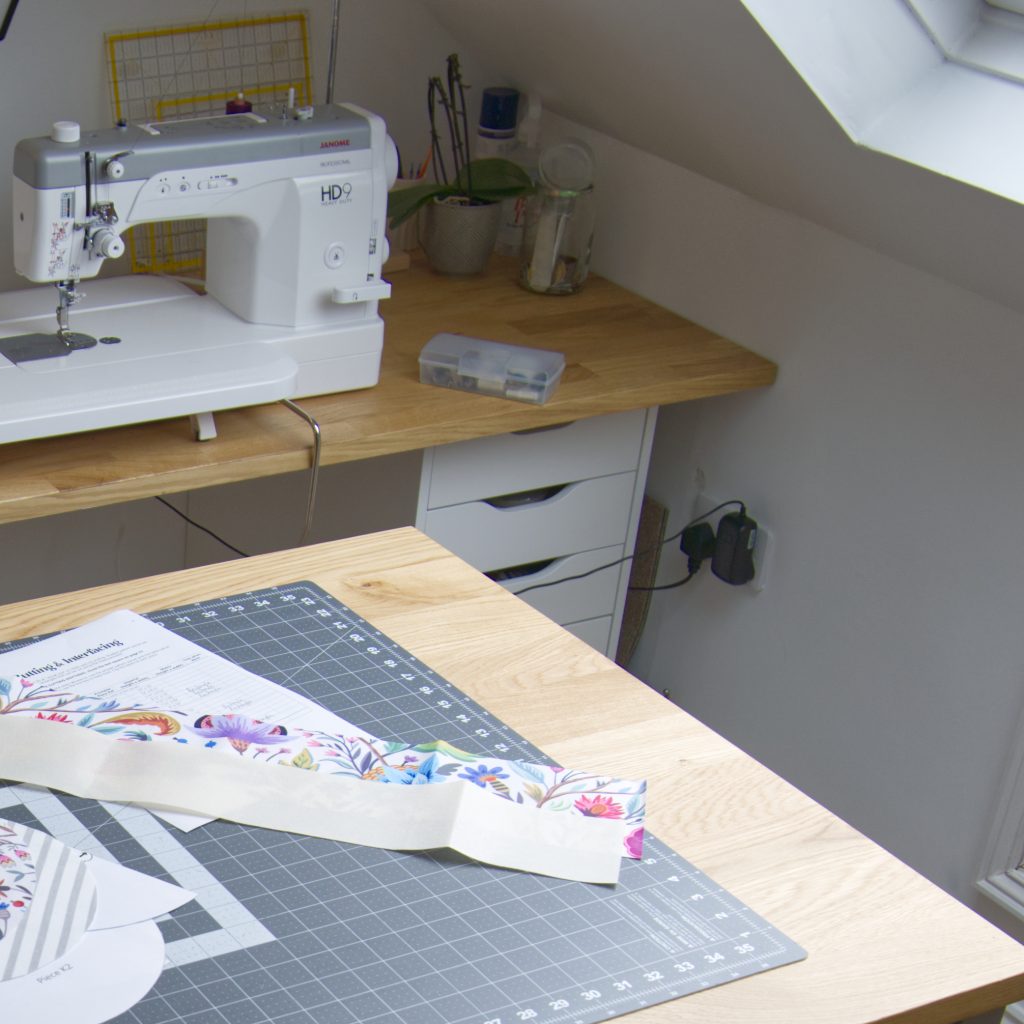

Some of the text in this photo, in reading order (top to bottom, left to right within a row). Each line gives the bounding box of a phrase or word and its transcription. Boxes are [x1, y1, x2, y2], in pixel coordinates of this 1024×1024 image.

[320, 140, 350, 148] JANOME
[321, 182, 352, 201] HD9
[16, 664, 57, 679] utting
[62, 638, 124, 664] Interfacing
[301, 597, 315, 605] 23
[317, 609, 331, 617] 22
[350, 634, 364, 642] 20
[384, 660, 397, 668] 18
[419, 686, 433, 694] 16
[437, 700, 452, 708] 15
[456, 714, 470, 723] 14
[475, 729, 489, 737] 13
[495, 743, 509, 752] 12
[36, 970, 61, 984] Piece
[517, 1009, 537, 1020] 28
[549, 999, 569, 1010] 29
[581, 990, 601, 1000] 30
[613, 980, 632, 991] 31
[644, 971, 664, 981] 32
[674, 962, 694, 972] 33
[704, 952, 724, 963] 34
[734, 944, 754, 954] 35
